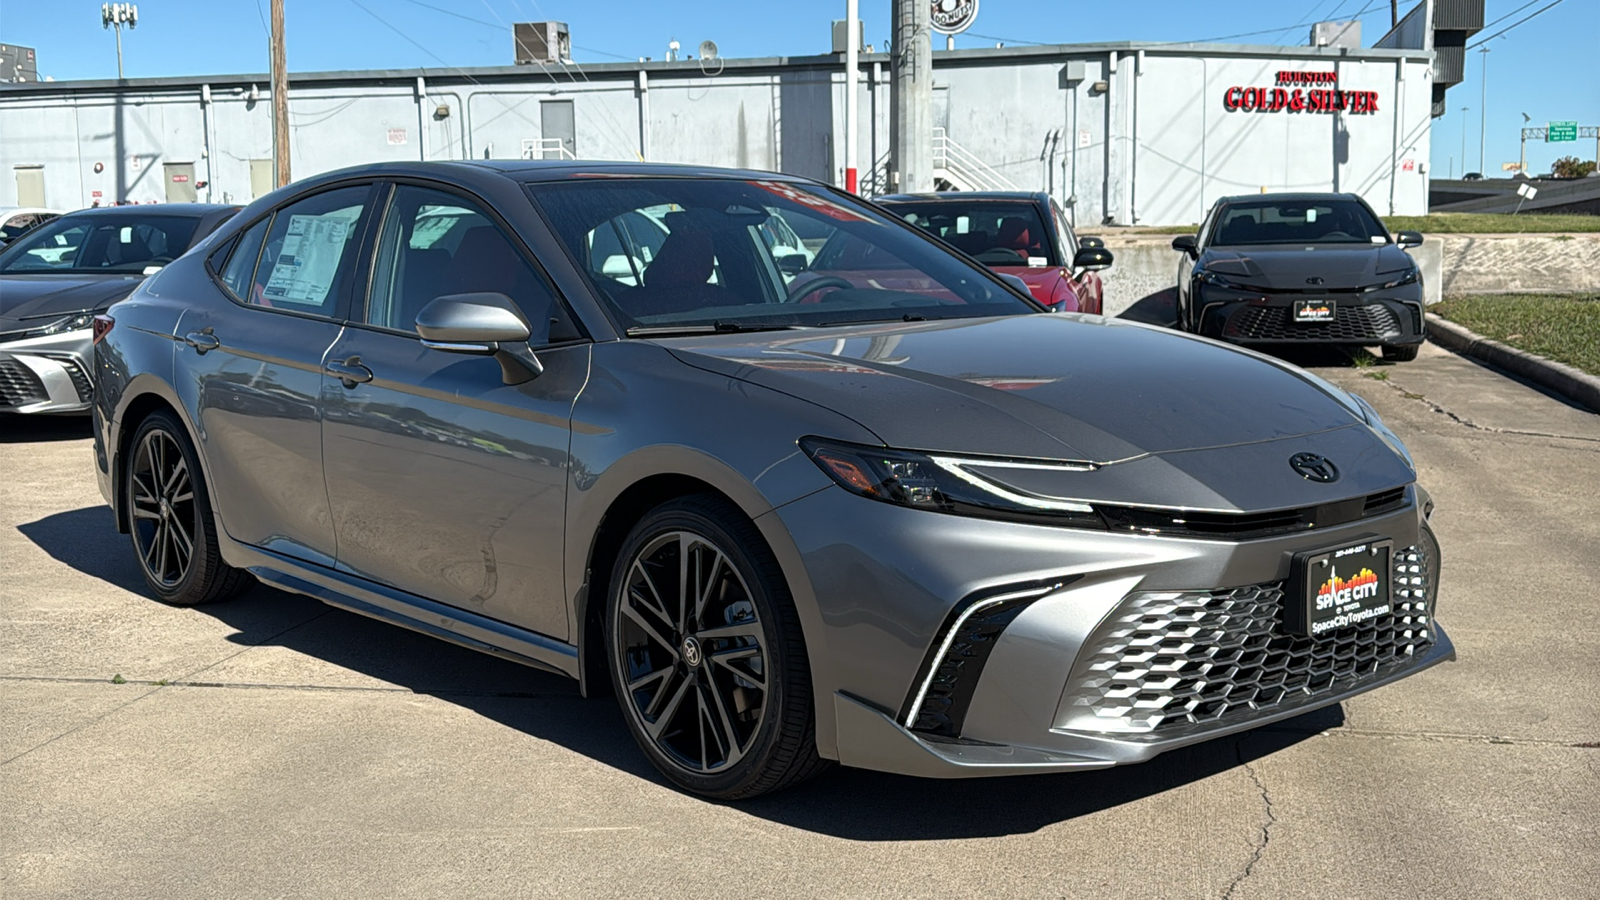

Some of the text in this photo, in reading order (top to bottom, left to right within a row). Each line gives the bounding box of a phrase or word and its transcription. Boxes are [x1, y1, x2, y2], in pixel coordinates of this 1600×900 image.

[1278, 71, 1337, 83] HOUSTON
[1225, 86, 1288, 111] GOLD
[1308, 89, 1379, 112] SILVER
[1316, 581, 1379, 610] SPACE CITY
[1312, 604, 1390, 634] SpaceCityToyota.com
